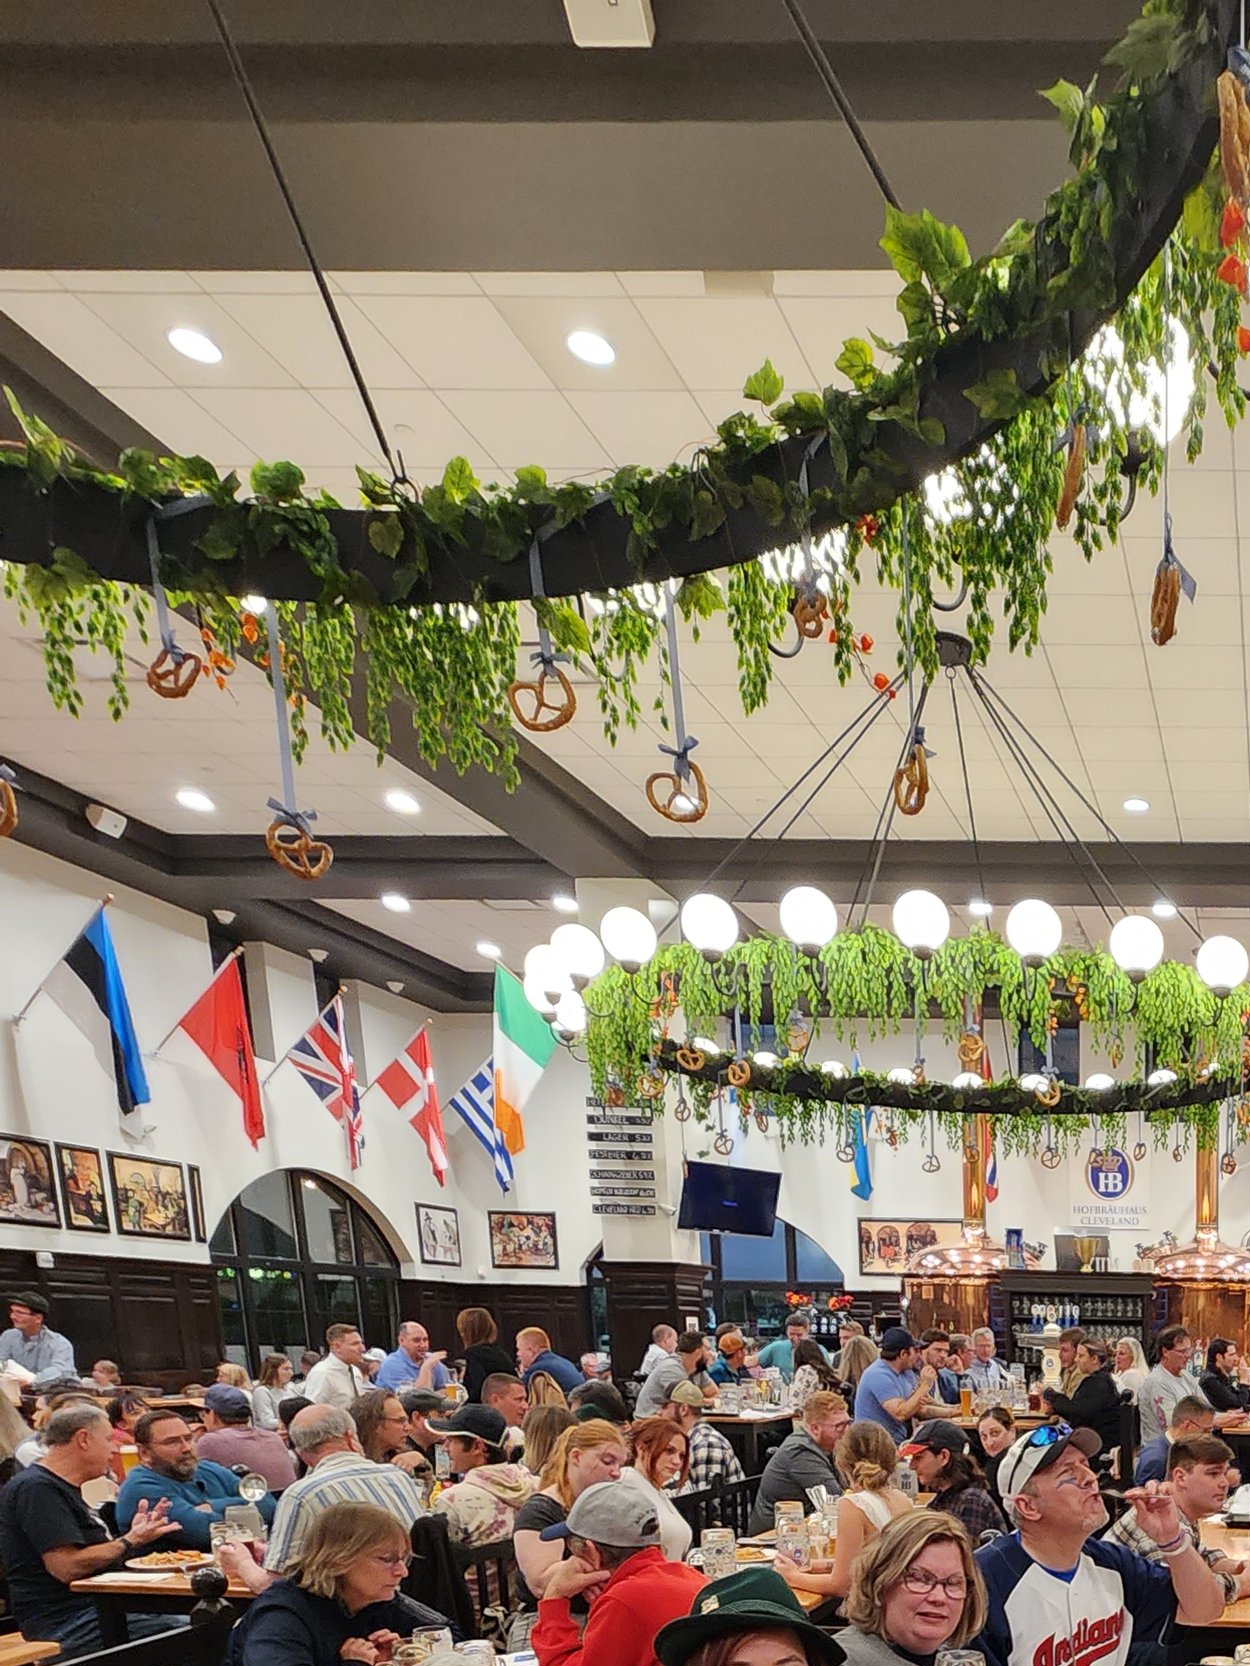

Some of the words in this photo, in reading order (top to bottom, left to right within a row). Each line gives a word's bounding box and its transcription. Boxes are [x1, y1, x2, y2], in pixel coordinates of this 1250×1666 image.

[603, 1133, 628, 1141] LAGER
[1098, 1172, 1123, 1192] HB
[1073, 1204, 1148, 1215] HOFBRÄUHAUS
[1080, 1217, 1140, 1225] CLEVELAND
